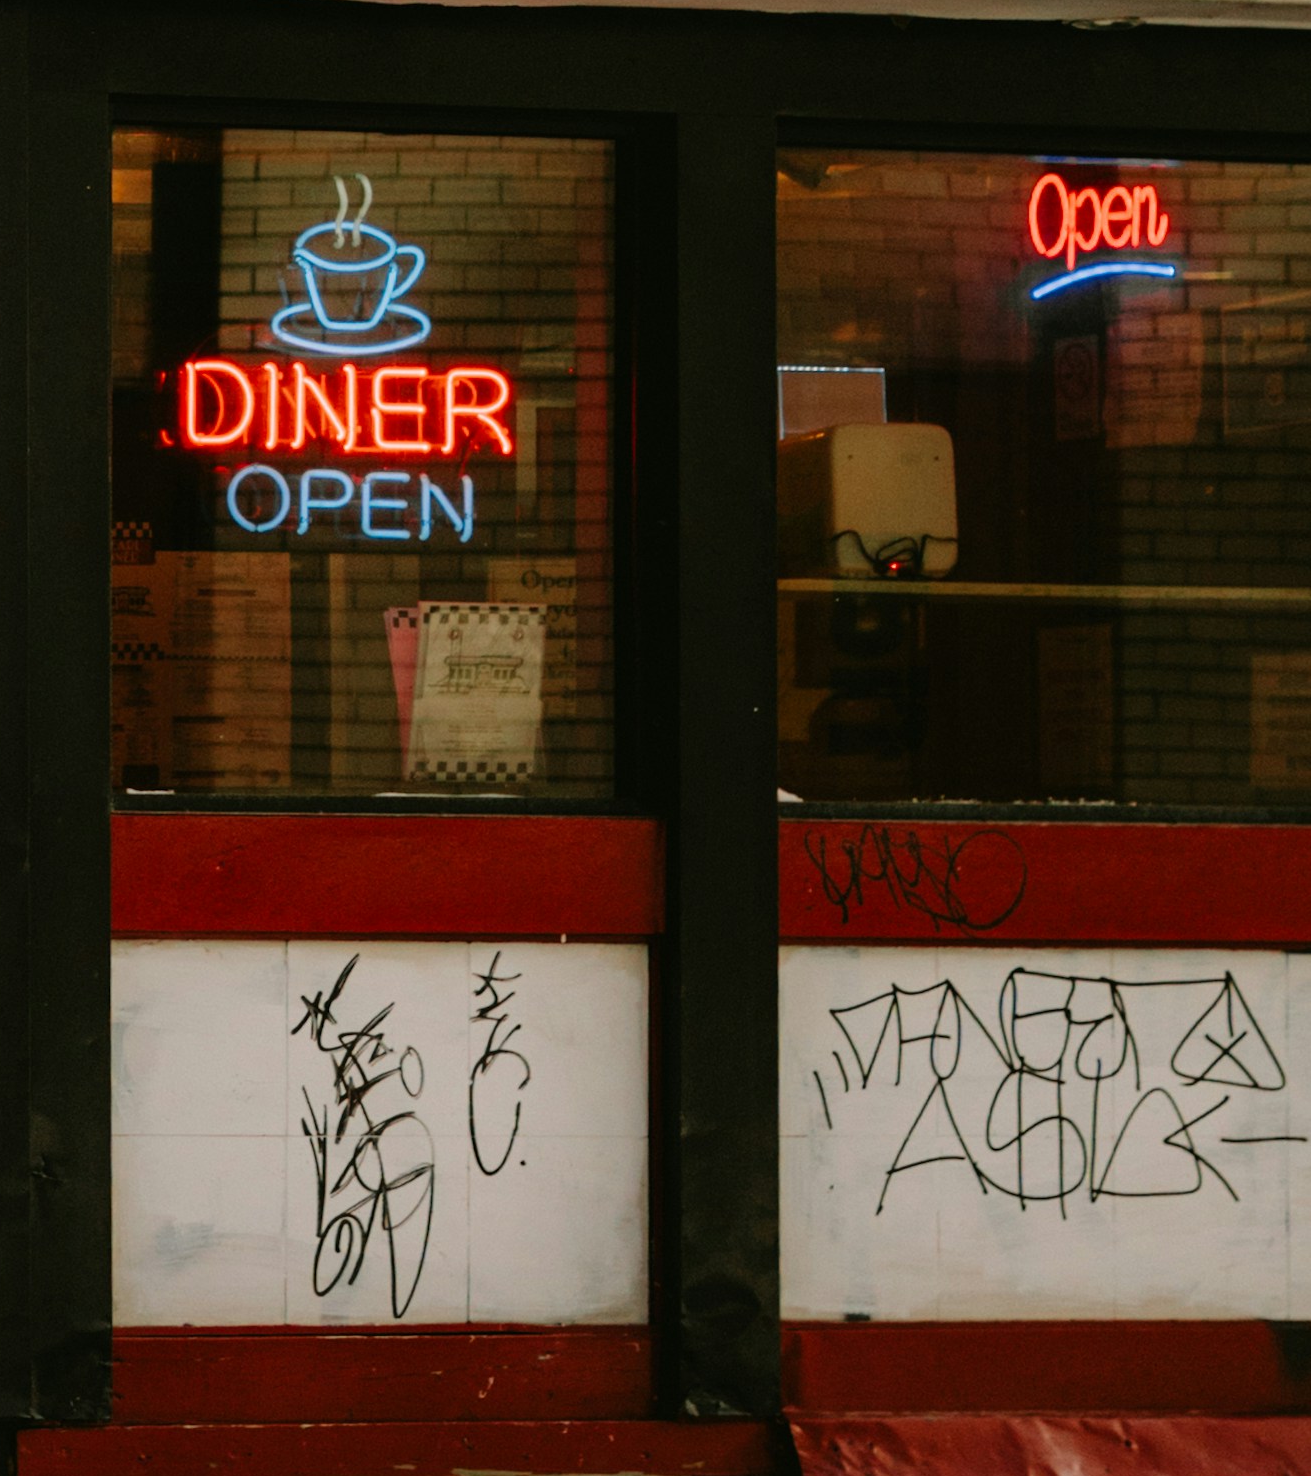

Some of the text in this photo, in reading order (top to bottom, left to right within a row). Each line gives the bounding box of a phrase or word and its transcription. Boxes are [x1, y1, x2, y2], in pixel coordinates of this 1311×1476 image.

[1028, 171, 1170, 269] Open
[181, 358, 515, 454] DINER
[226, 465, 474, 542] OPEN
